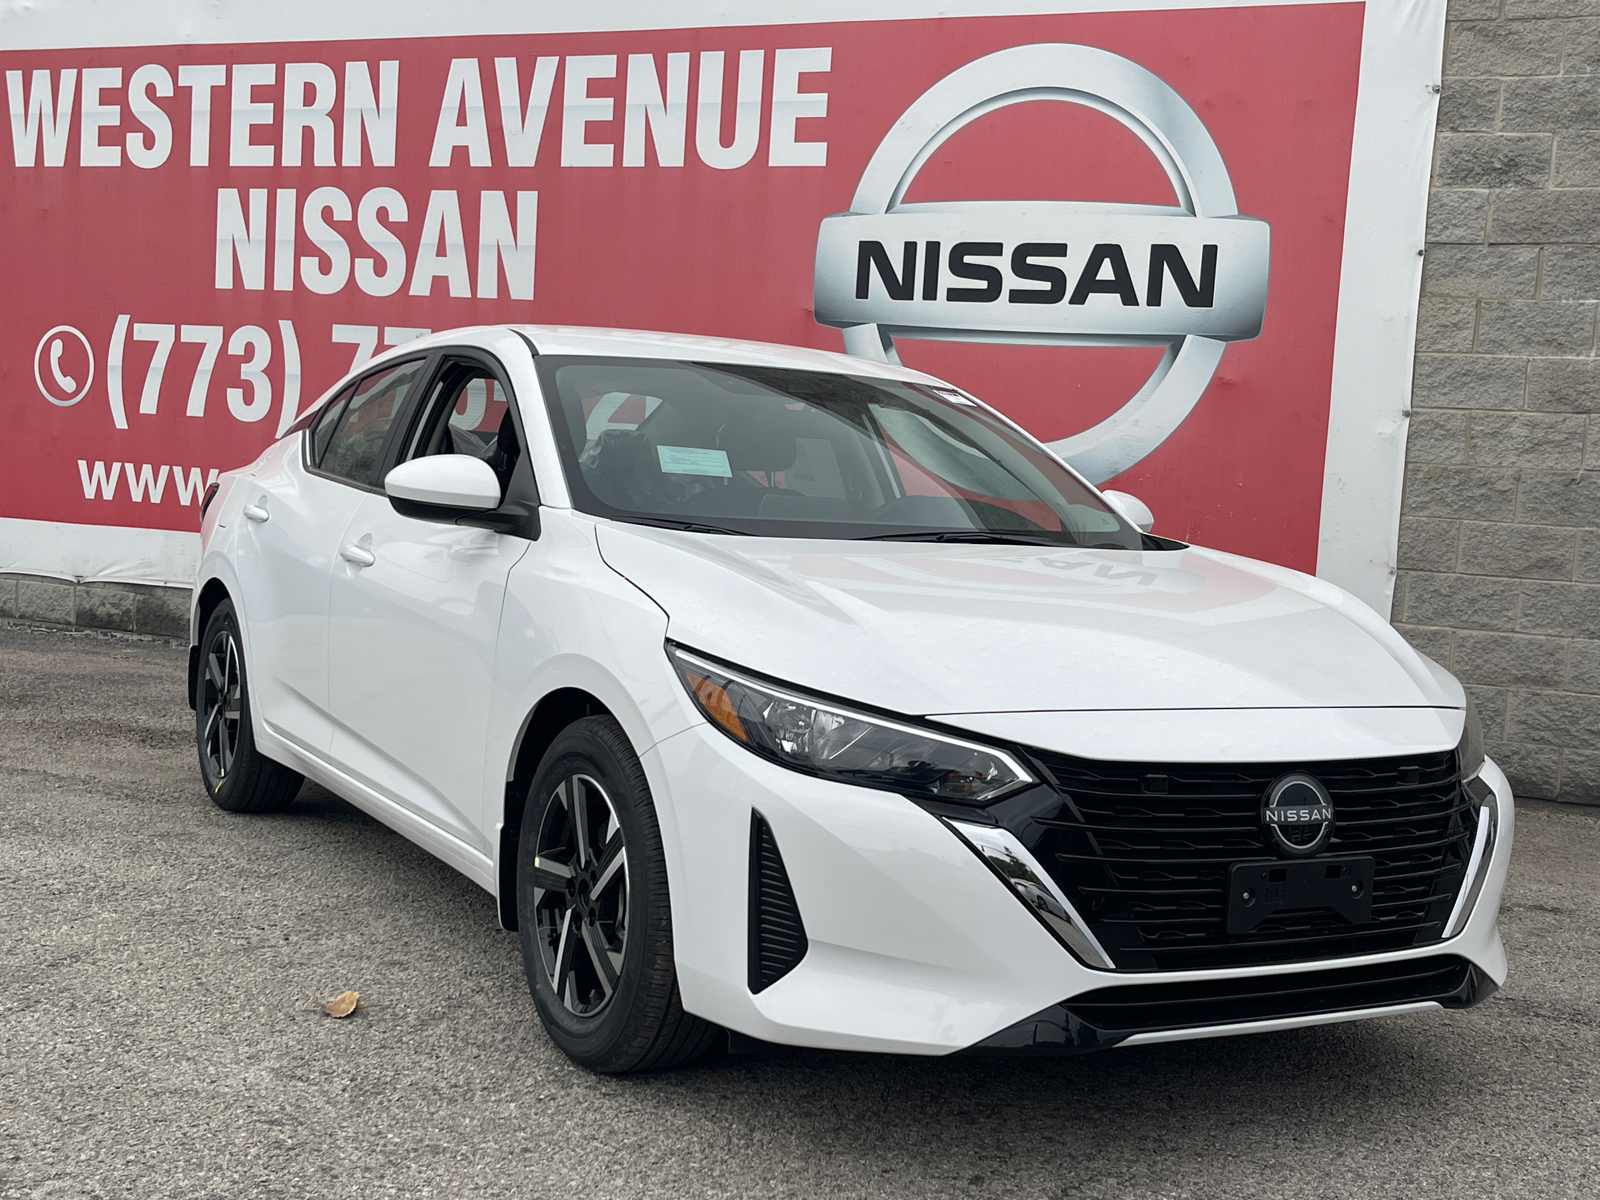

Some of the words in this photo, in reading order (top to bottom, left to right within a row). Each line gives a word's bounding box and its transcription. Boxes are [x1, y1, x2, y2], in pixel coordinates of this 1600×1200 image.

[4, 60, 400, 169] WESTERN
[428, 47, 833, 169] AVENUE
[214, 186, 538, 300] NISSAN
[856, 240, 1218, 307] NISSAN
[107, 314, 301, 440] (773)
[1265, 808, 1332, 821] NISSAN
